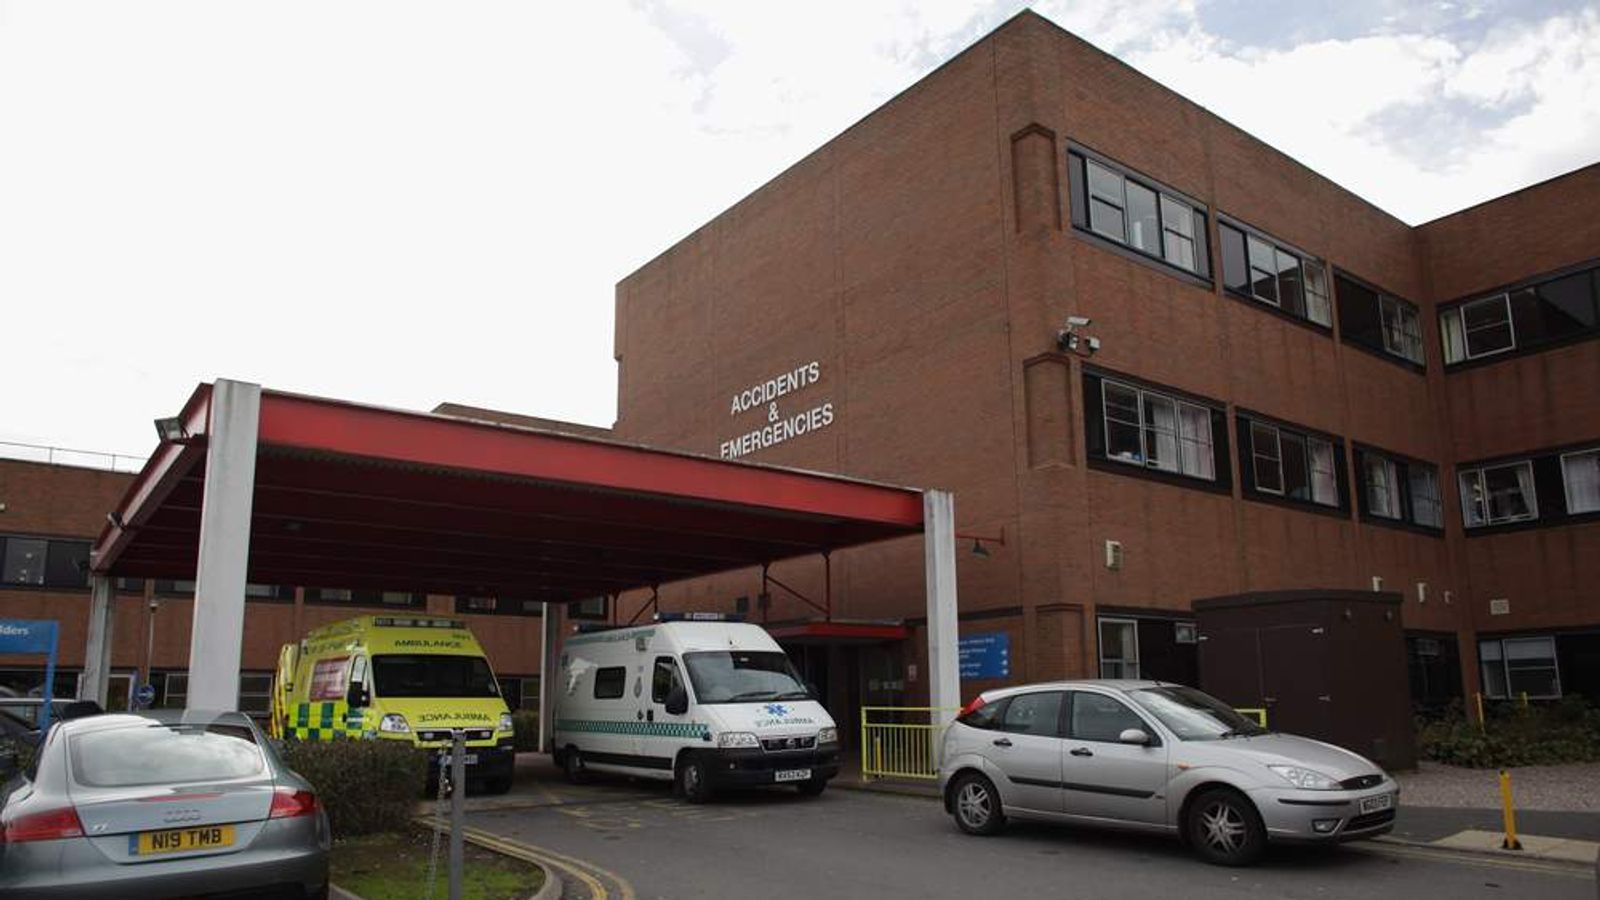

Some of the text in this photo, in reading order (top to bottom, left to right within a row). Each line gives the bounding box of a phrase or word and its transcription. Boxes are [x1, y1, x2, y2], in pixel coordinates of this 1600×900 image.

[731, 361, 820, 415] ACCIDENTS
[768, 402, 779, 422] &
[720, 403, 834, 460] EMERGENCIES
[394, 639, 462, 649] AMBULANCE
[151, 828, 222, 849] N19 TMB
